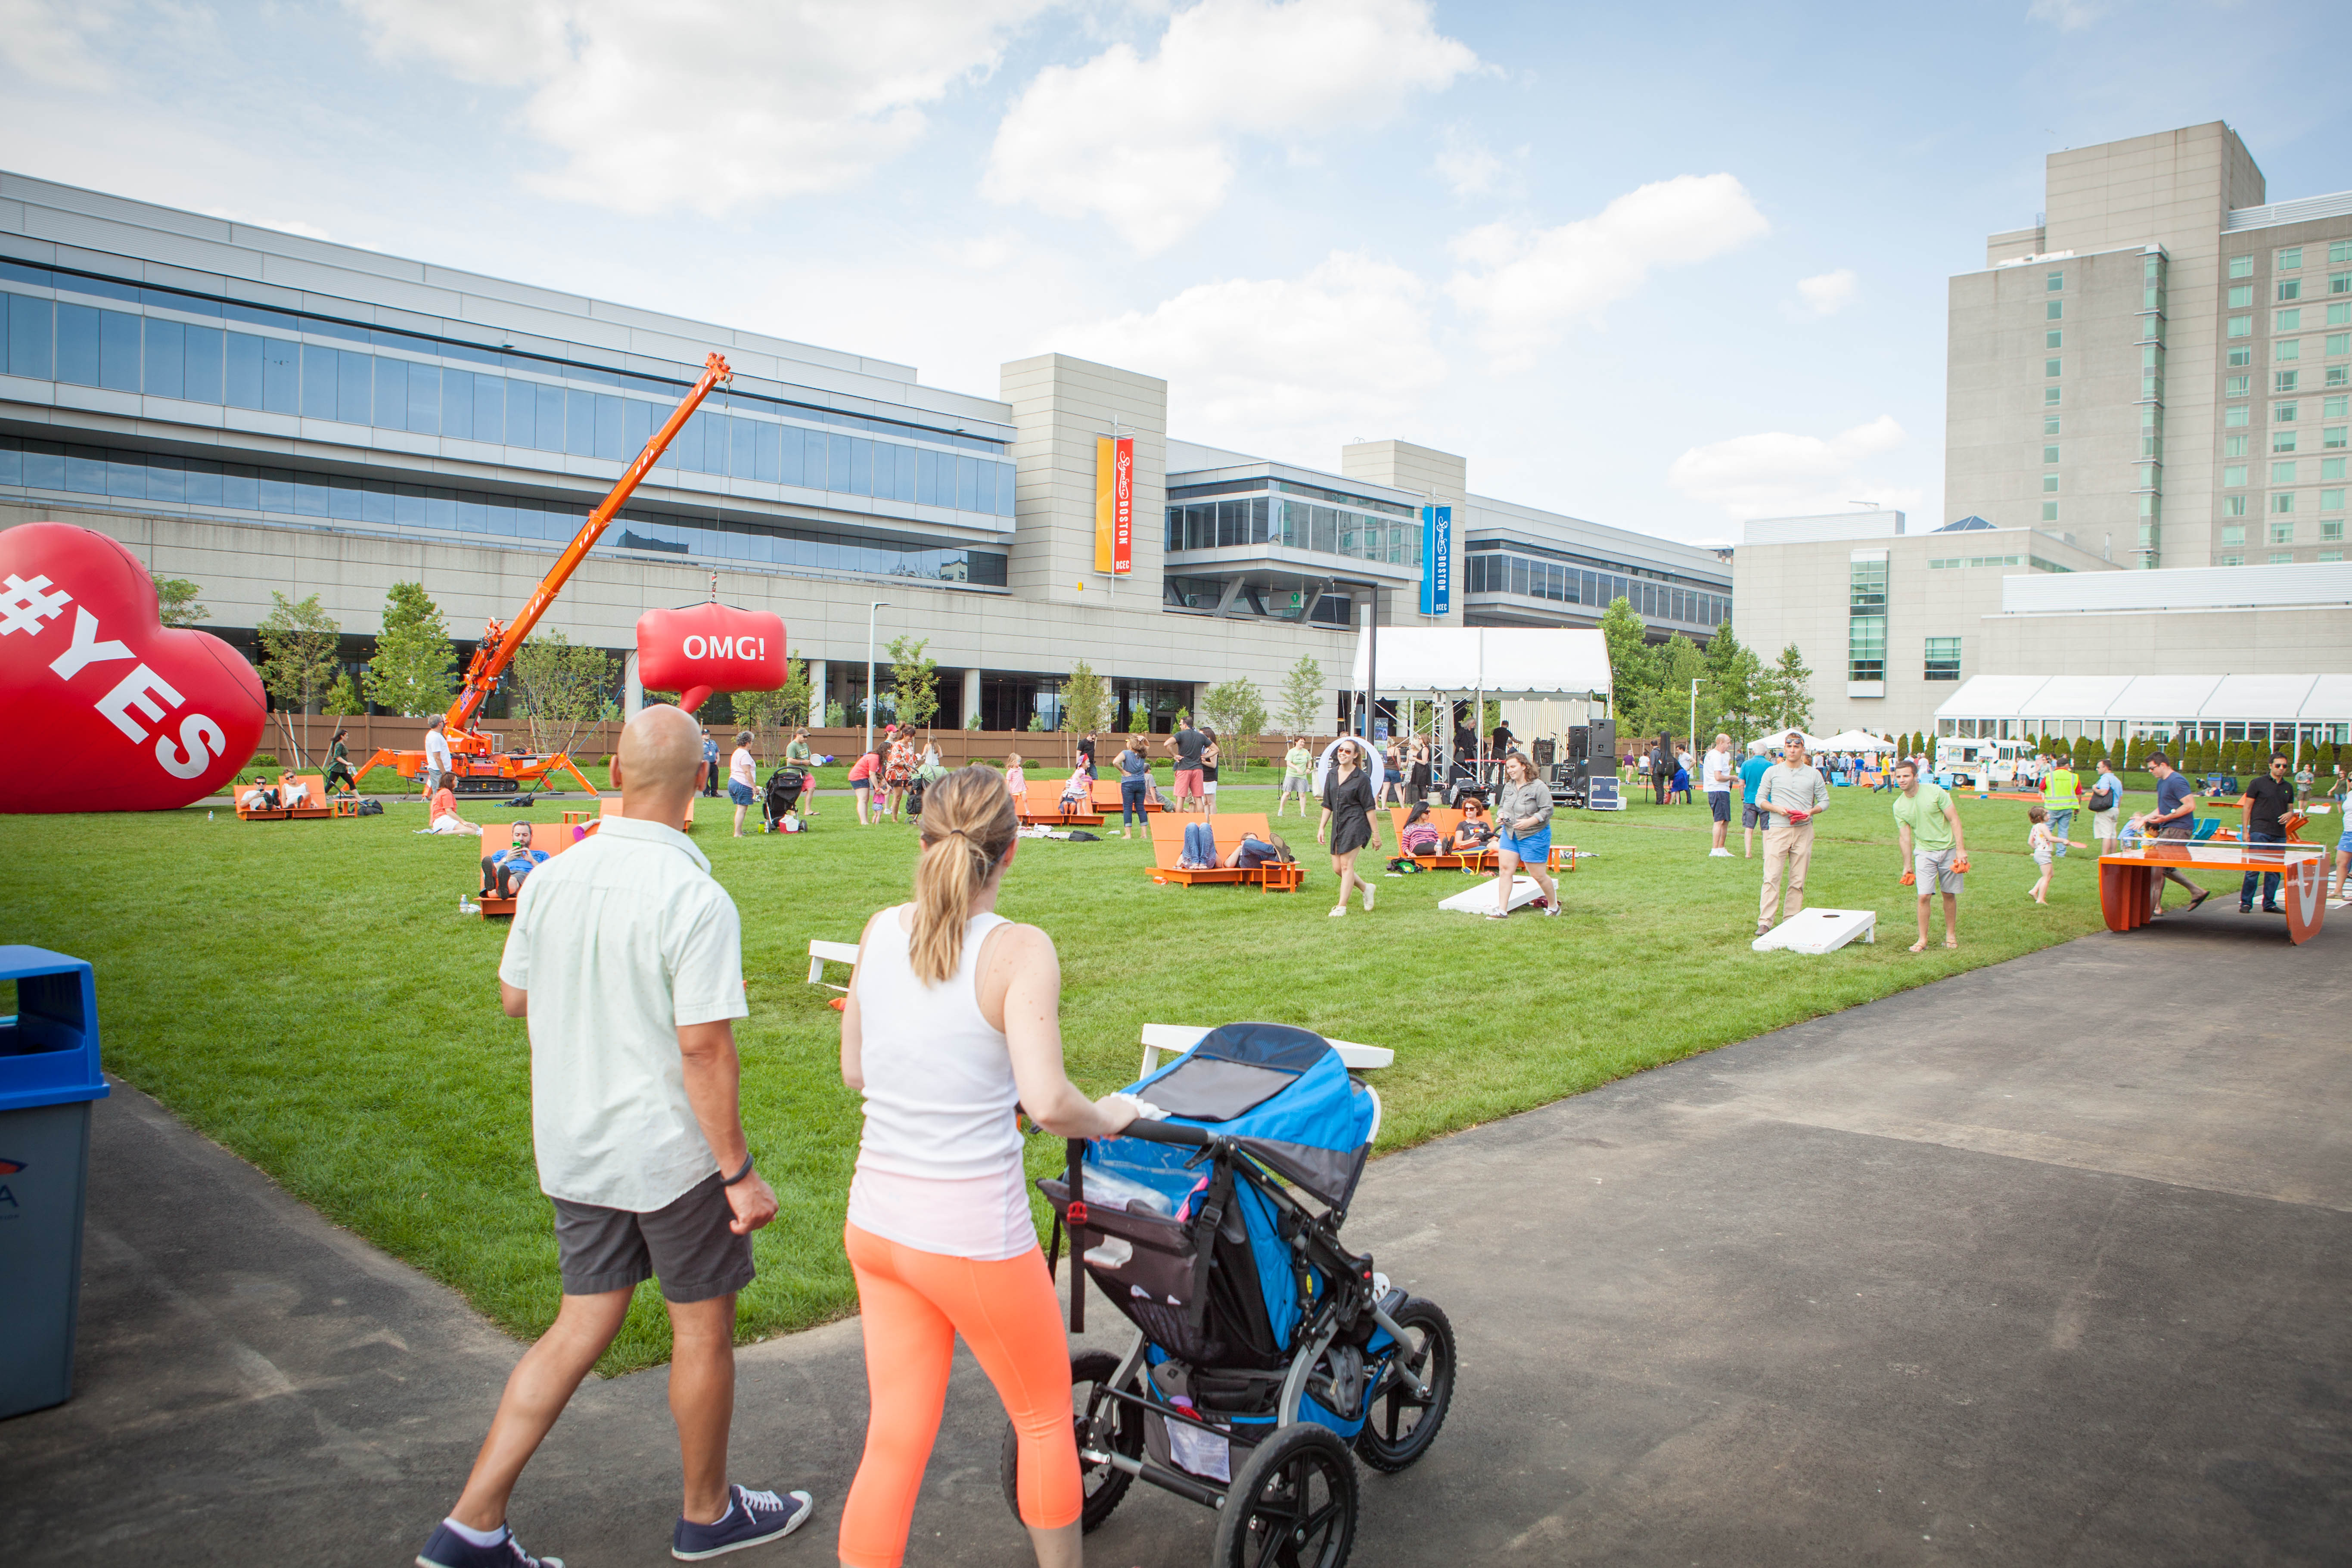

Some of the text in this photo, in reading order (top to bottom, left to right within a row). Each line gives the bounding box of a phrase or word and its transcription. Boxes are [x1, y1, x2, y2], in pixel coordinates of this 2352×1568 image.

[1118, 451, 1130, 545] Signature BOSTON
[1116, 560, 1129, 570] BCEC
[1436, 516, 1448, 590] Signature BOSTON
[0, 574, 226, 779] #YES
[683, 635, 765, 660] OMG!
